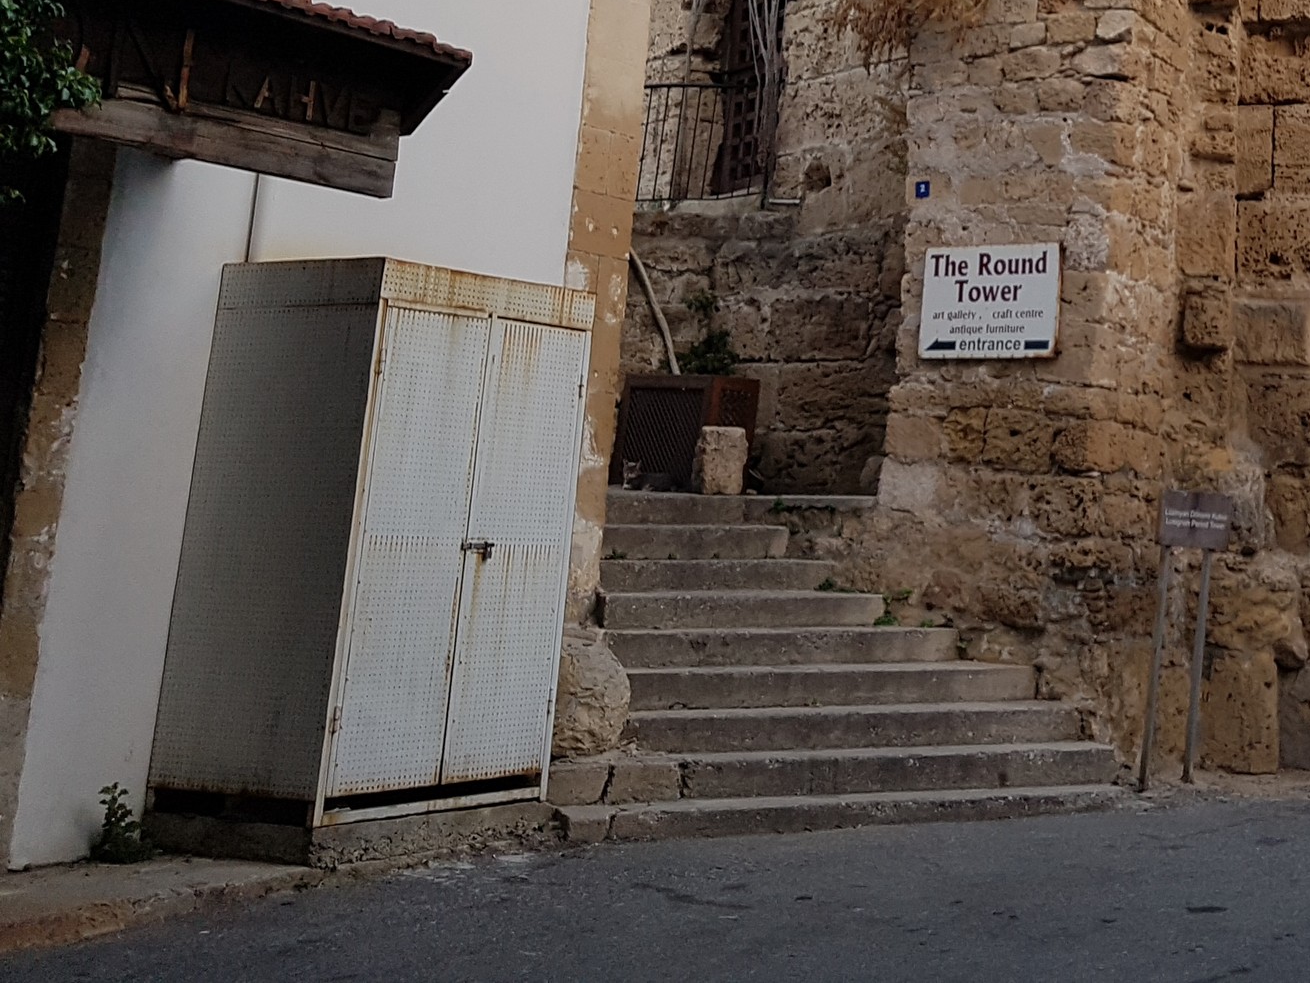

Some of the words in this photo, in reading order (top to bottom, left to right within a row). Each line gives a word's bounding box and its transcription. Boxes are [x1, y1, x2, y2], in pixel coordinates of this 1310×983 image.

[930, 254, 969, 277] The
[978, 250, 1048, 276] Round
[954, 279, 1022, 302] Tower
[932, 310, 945, 320] art
[992, 309, 1013, 319] craft
[1015, 309, 1044, 319] centre
[949, 324, 983, 335] antique
[985, 323, 1025, 334] furniture
[959, 337, 1021, 351] entrance
